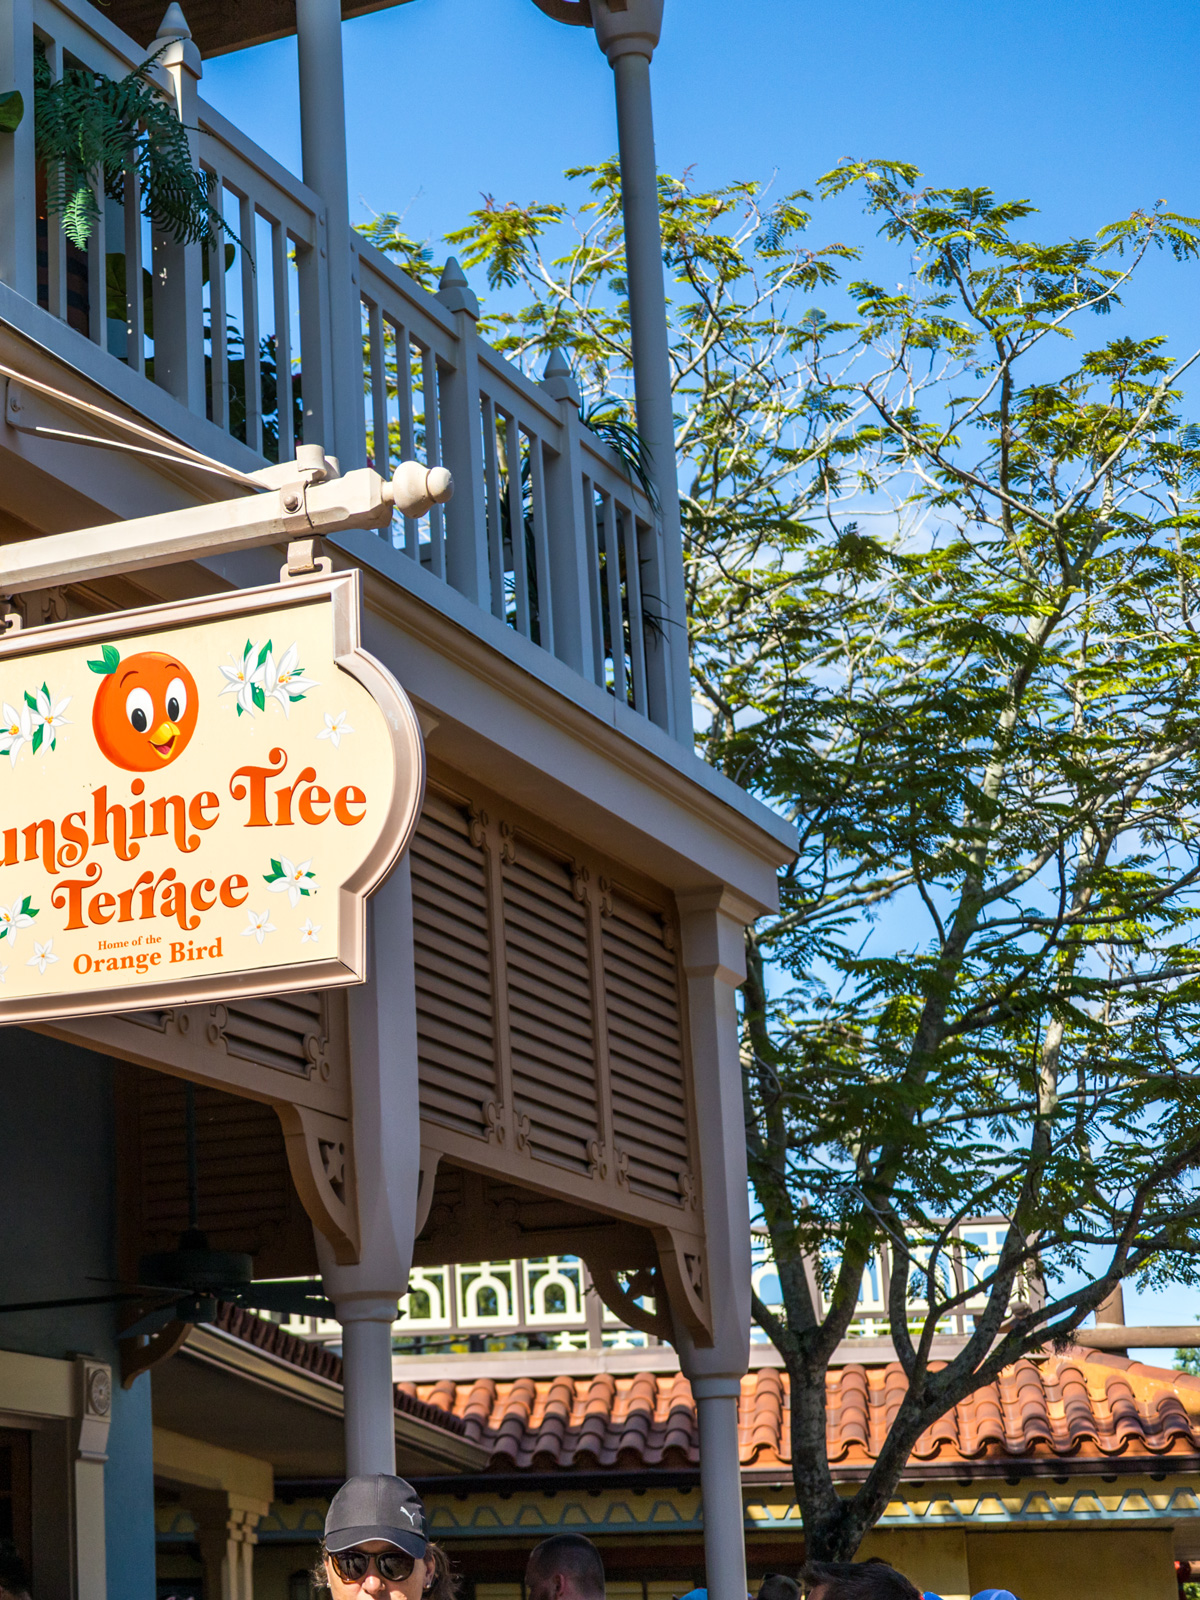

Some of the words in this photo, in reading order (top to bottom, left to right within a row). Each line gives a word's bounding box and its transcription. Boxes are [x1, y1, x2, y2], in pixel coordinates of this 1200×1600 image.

[229, 747, 367, 828] Tree
[51, 862, 250, 931] Terrace
[72, 951, 162, 975] Orange
[168, 936, 224, 964] Bird
[97, 940, 130, 951] Home
[131, 936, 143, 946] of
[145, 934, 162, 945] the
